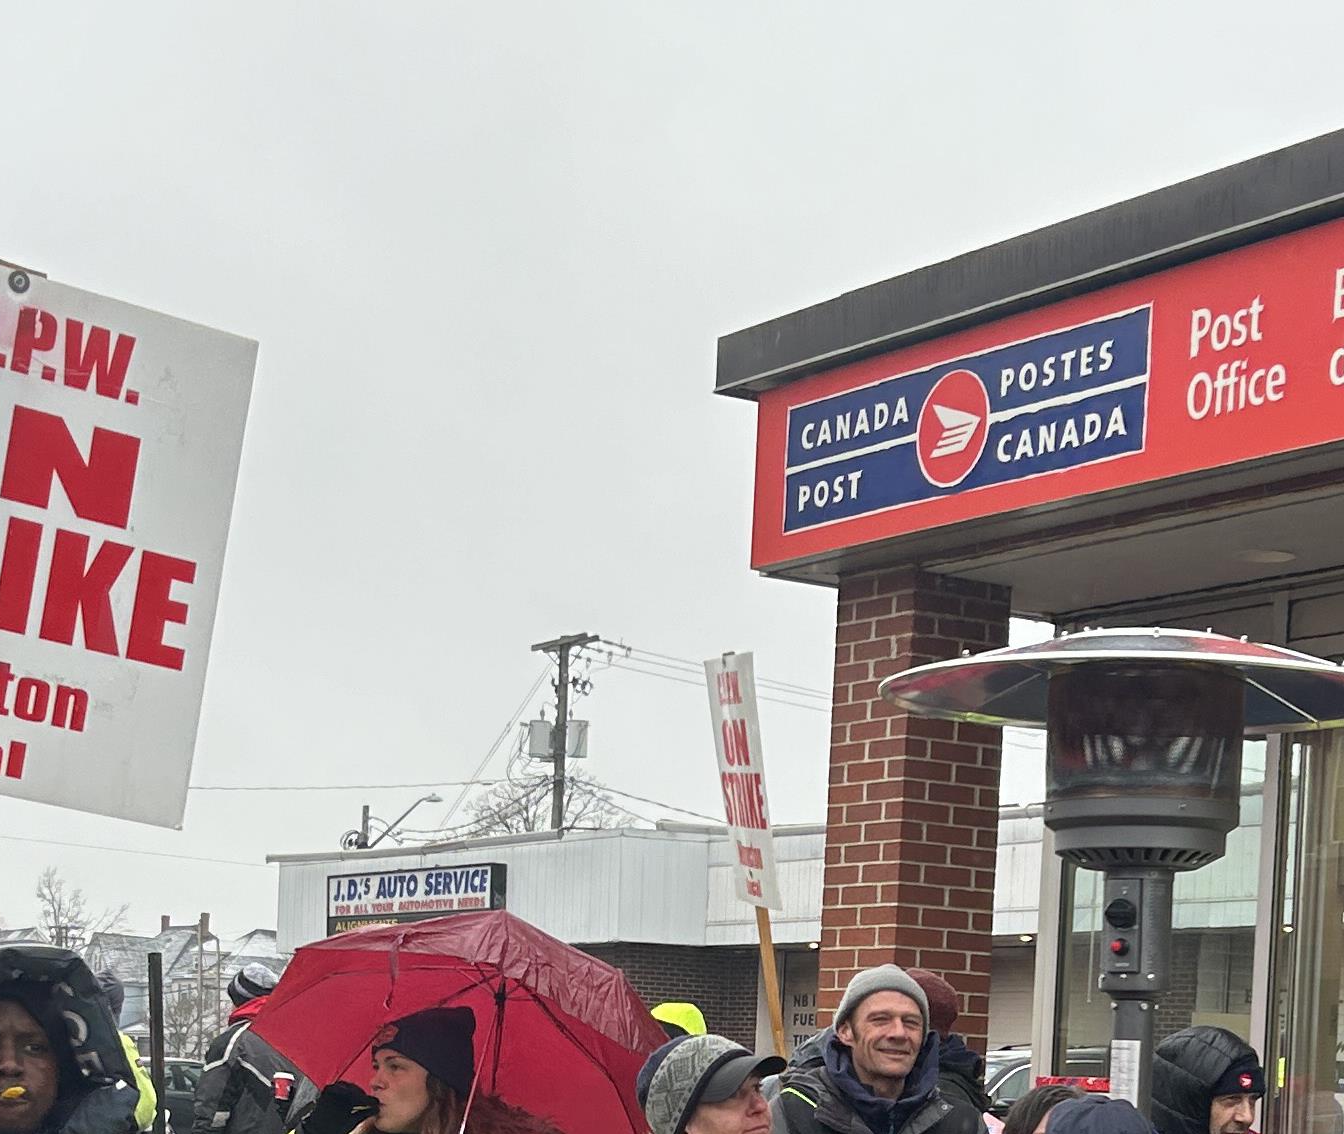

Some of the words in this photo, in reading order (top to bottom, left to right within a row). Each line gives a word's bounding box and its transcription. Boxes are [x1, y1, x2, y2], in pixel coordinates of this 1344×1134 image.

[1188, 295, 1264, 357] Post
[999, 339, 1116, 397] POSTES
[1186, 357, 1287, 420] Office
[800, 396, 910, 451] CANADA
[996, 404, 1128, 463] CANADA
[797, 468, 864, 513] POST
[722, 718, 750, 767] ON
[335, 904, 351, 916] FOR
[354, 902, 369, 914] ALL
[372, 900, 394, 913] YOUR
[398, 898, 454, 913] AUTOMOTIVE
[457, 895, 486, 910] NEEDS
[376, 873, 418, 900] AUTO
[424, 868, 489, 897] SERVICE
[793, 993, 808, 1008] NB
[793, 1013, 815, 1027] FUE
